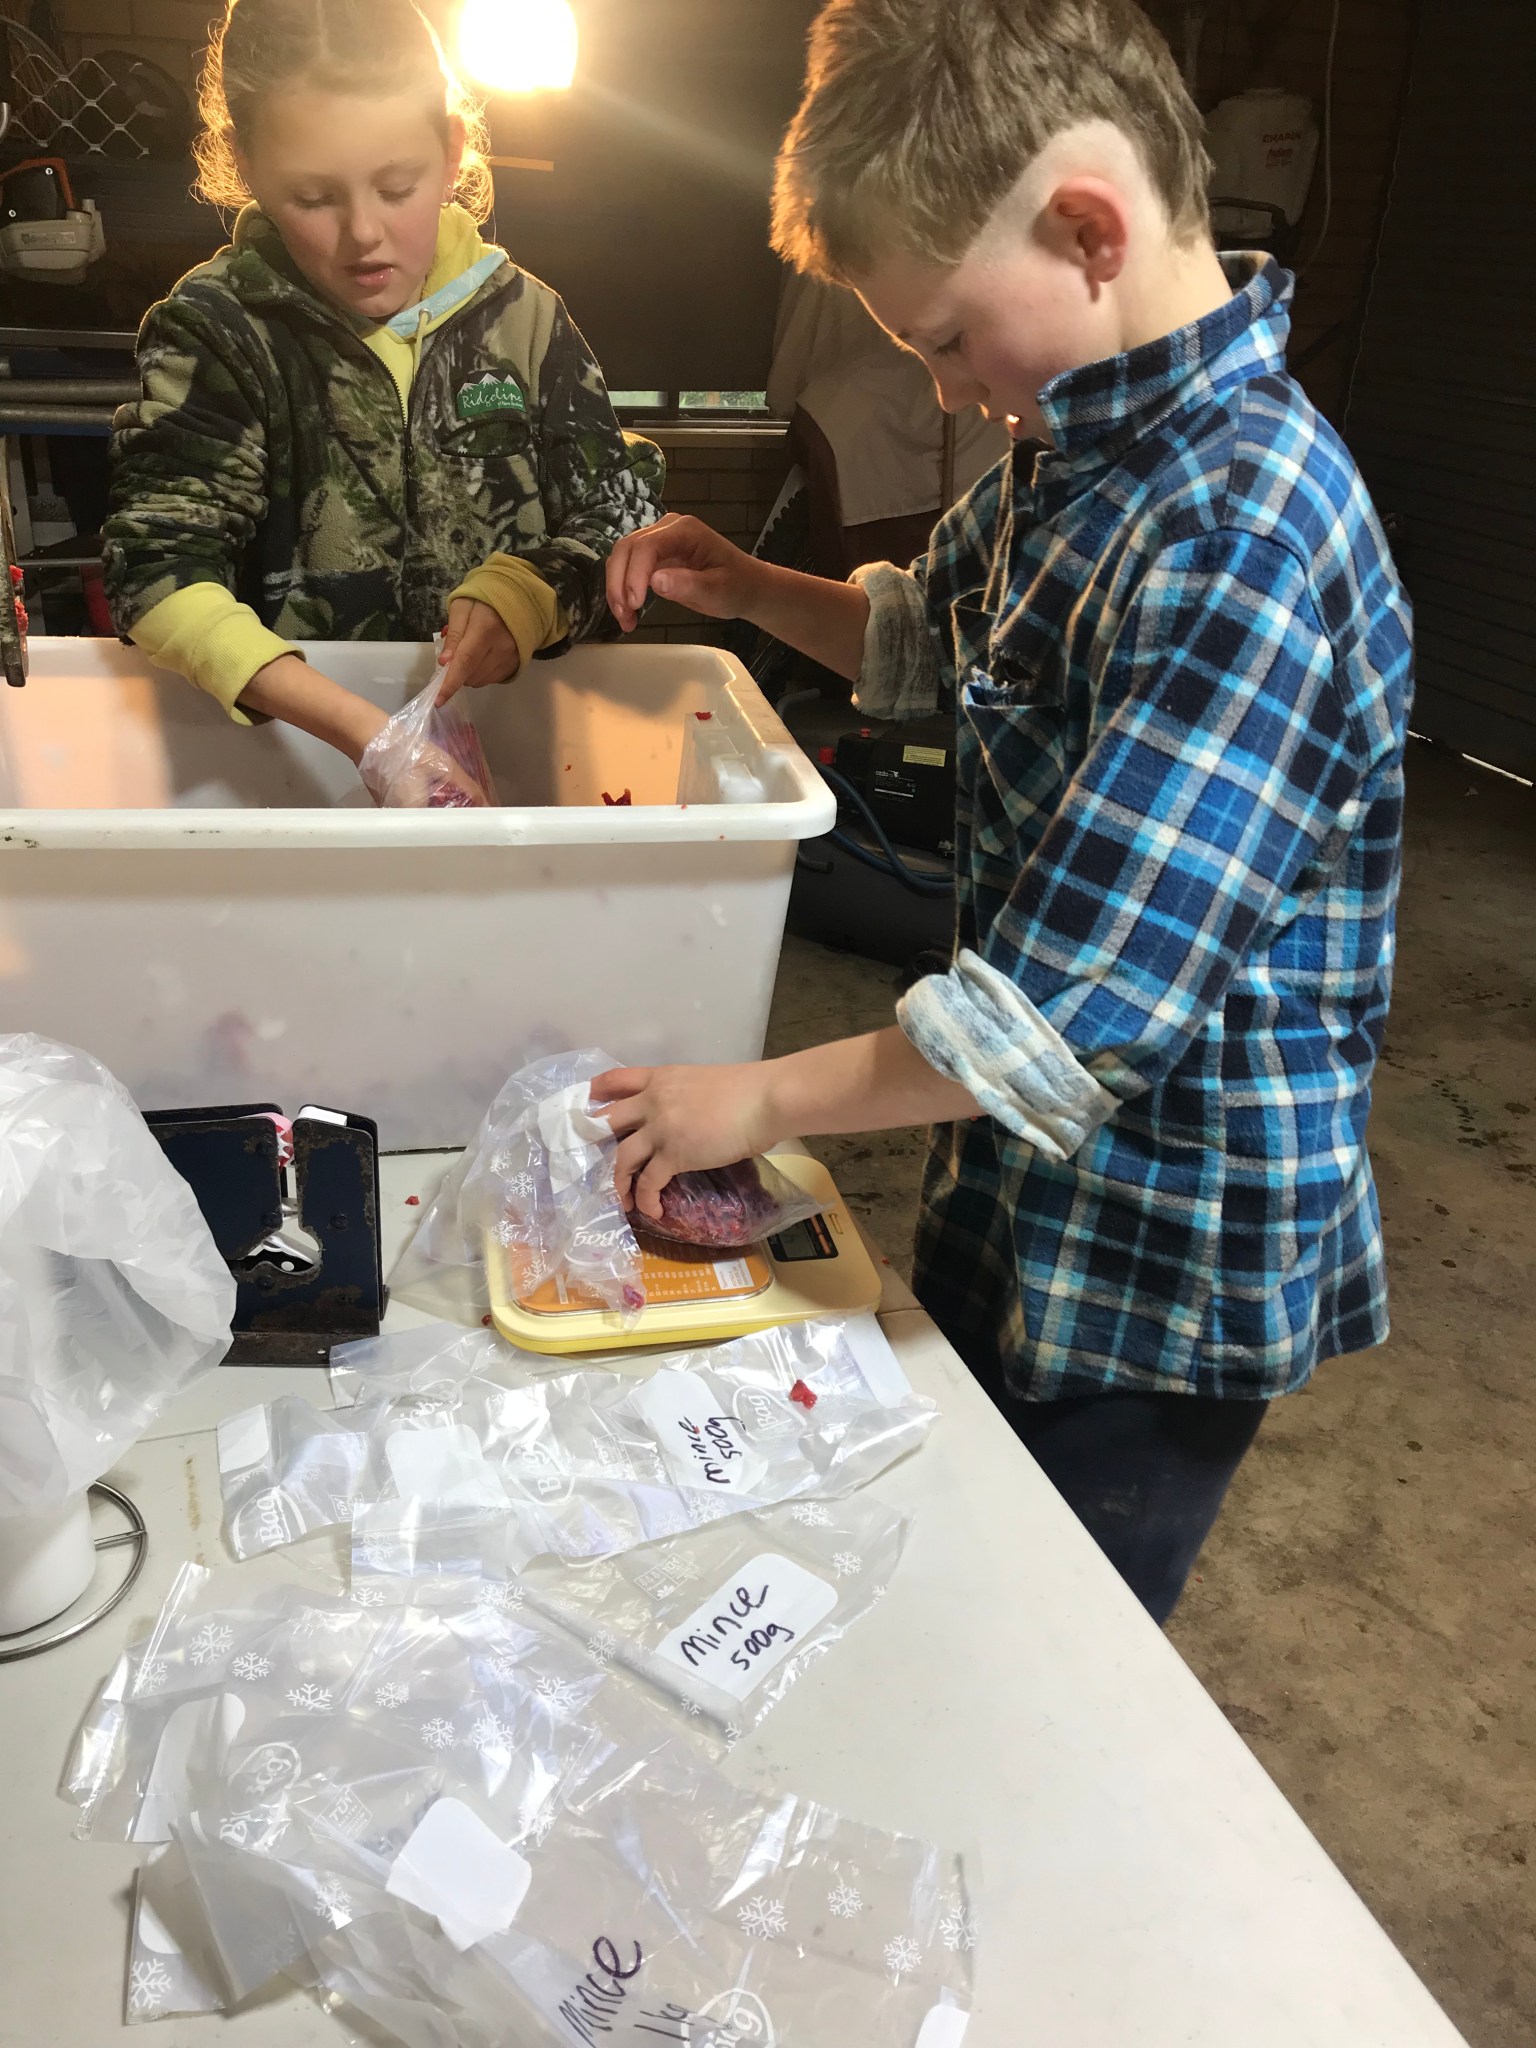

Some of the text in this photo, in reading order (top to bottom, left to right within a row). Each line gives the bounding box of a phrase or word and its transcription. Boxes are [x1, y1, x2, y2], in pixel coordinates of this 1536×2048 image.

[573, 1229, 617, 1248] Bag
[748, 1394, 779, 1429] Bag
[730, 1623, 795, 1671] 500g
